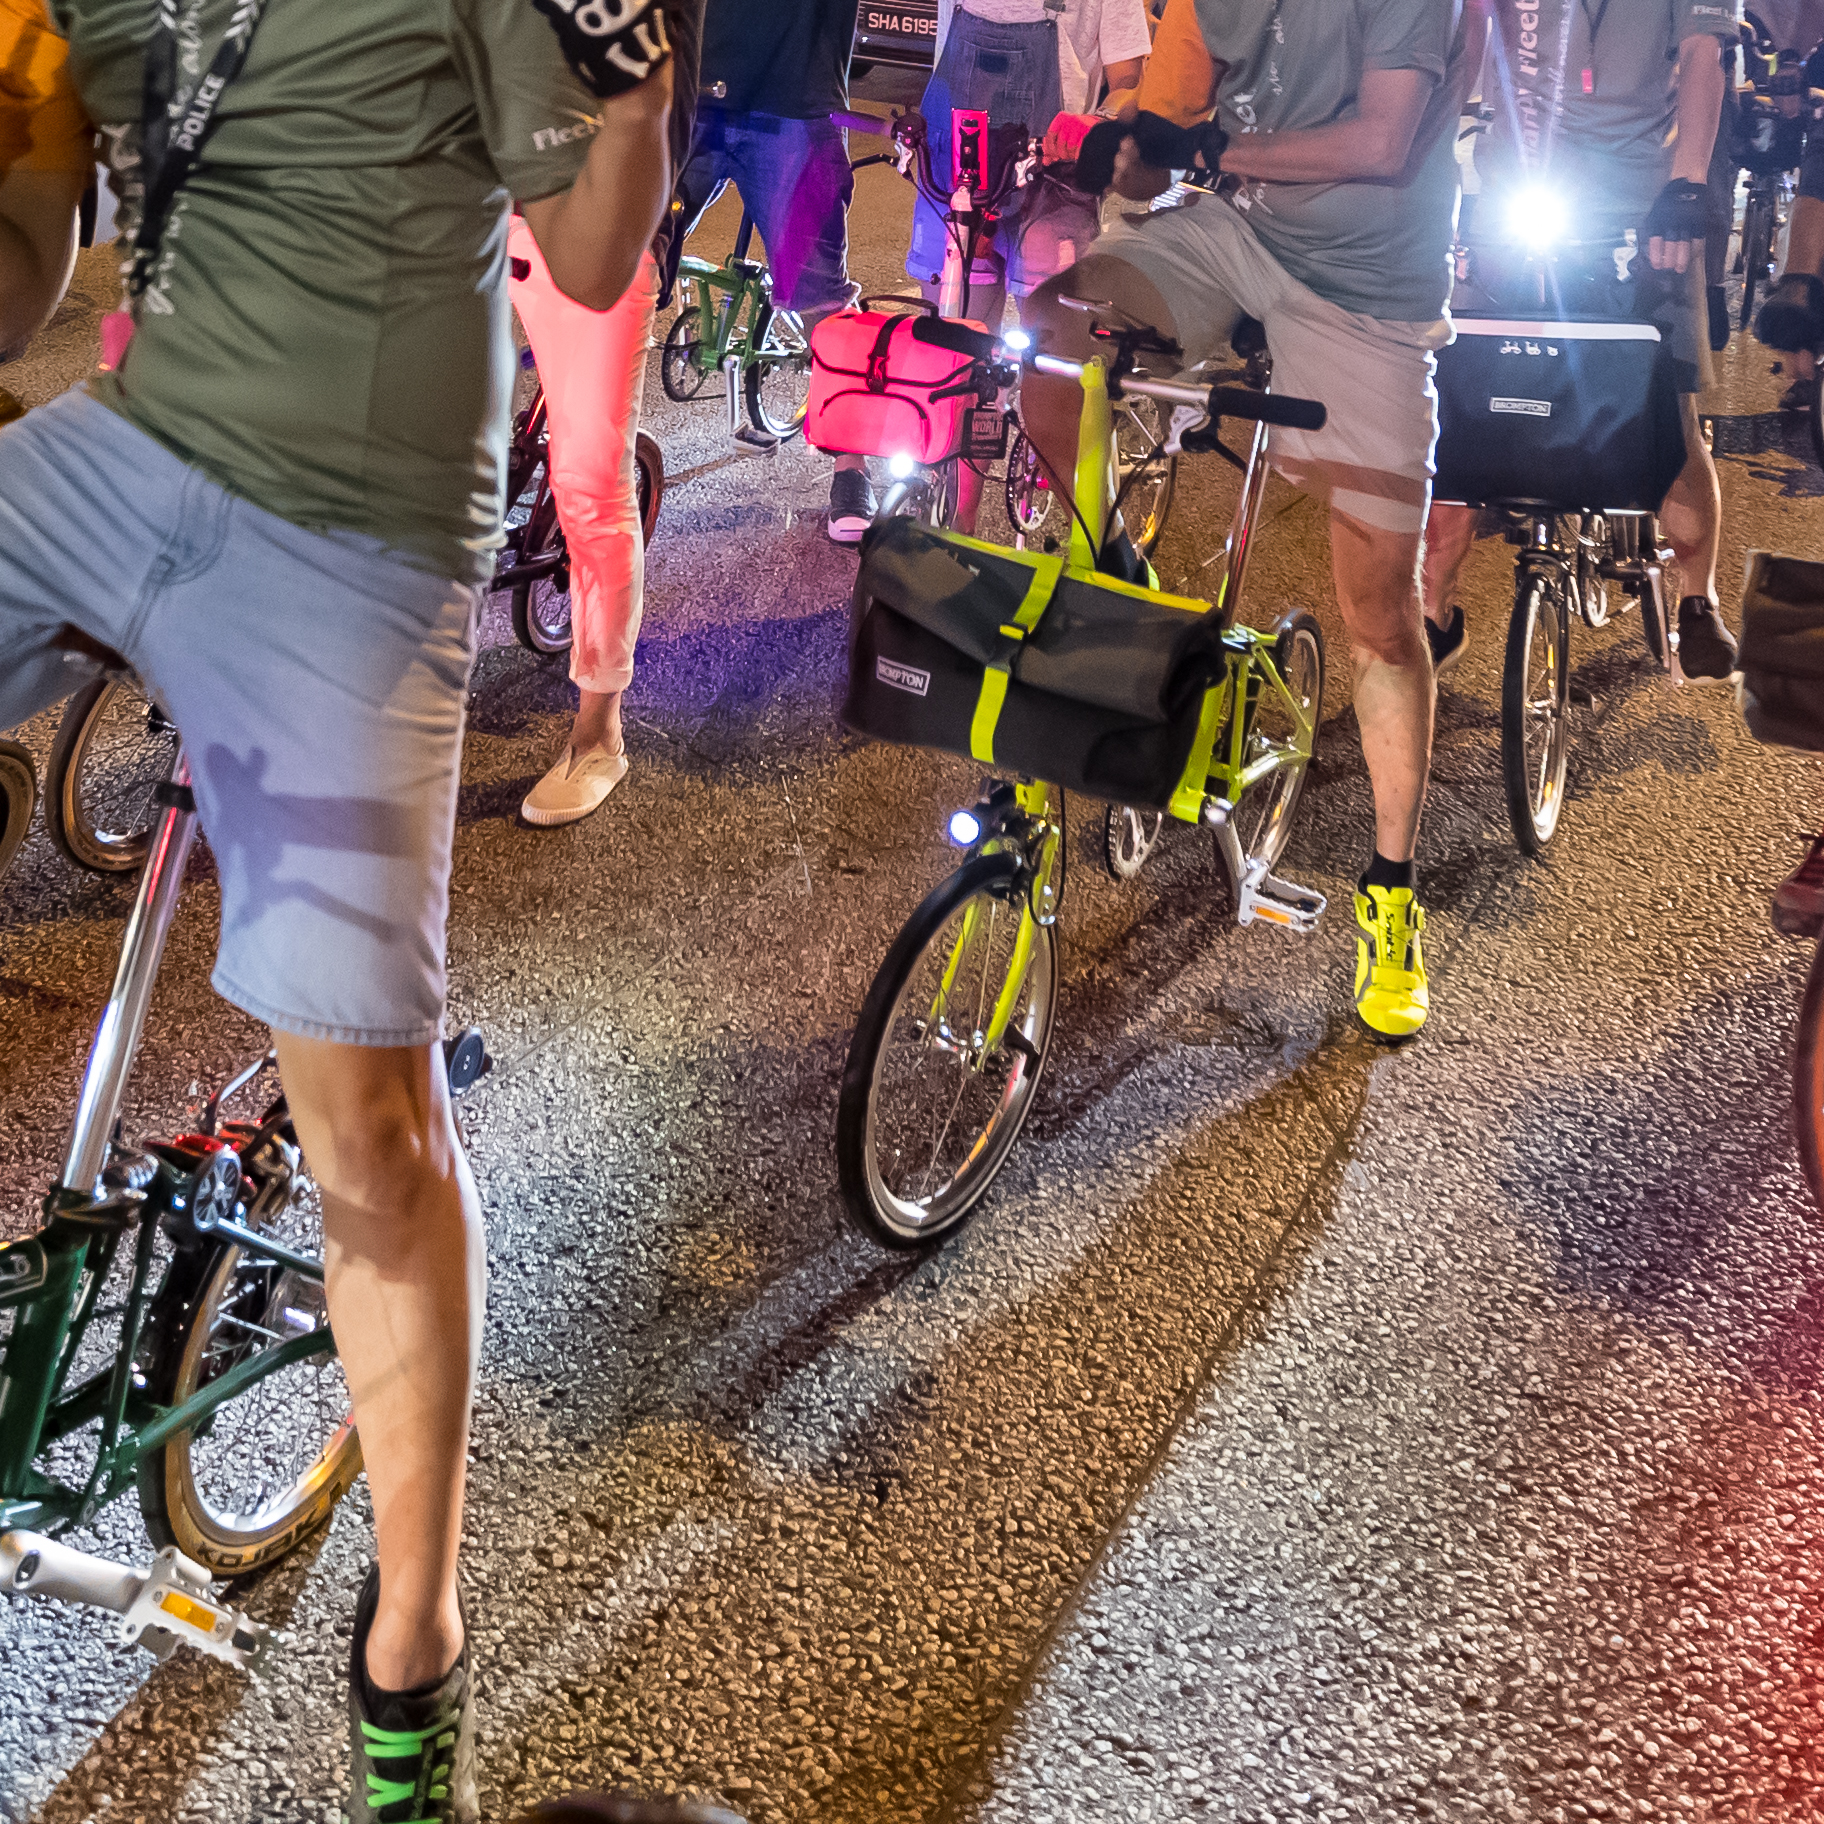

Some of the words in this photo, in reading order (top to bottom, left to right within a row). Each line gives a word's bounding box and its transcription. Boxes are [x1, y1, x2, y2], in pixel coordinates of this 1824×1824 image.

[868, 12, 938, 36] SHA6195
[176, 73, 225, 151] POLICE
[196, 1511, 321, 1567] KOJAK
